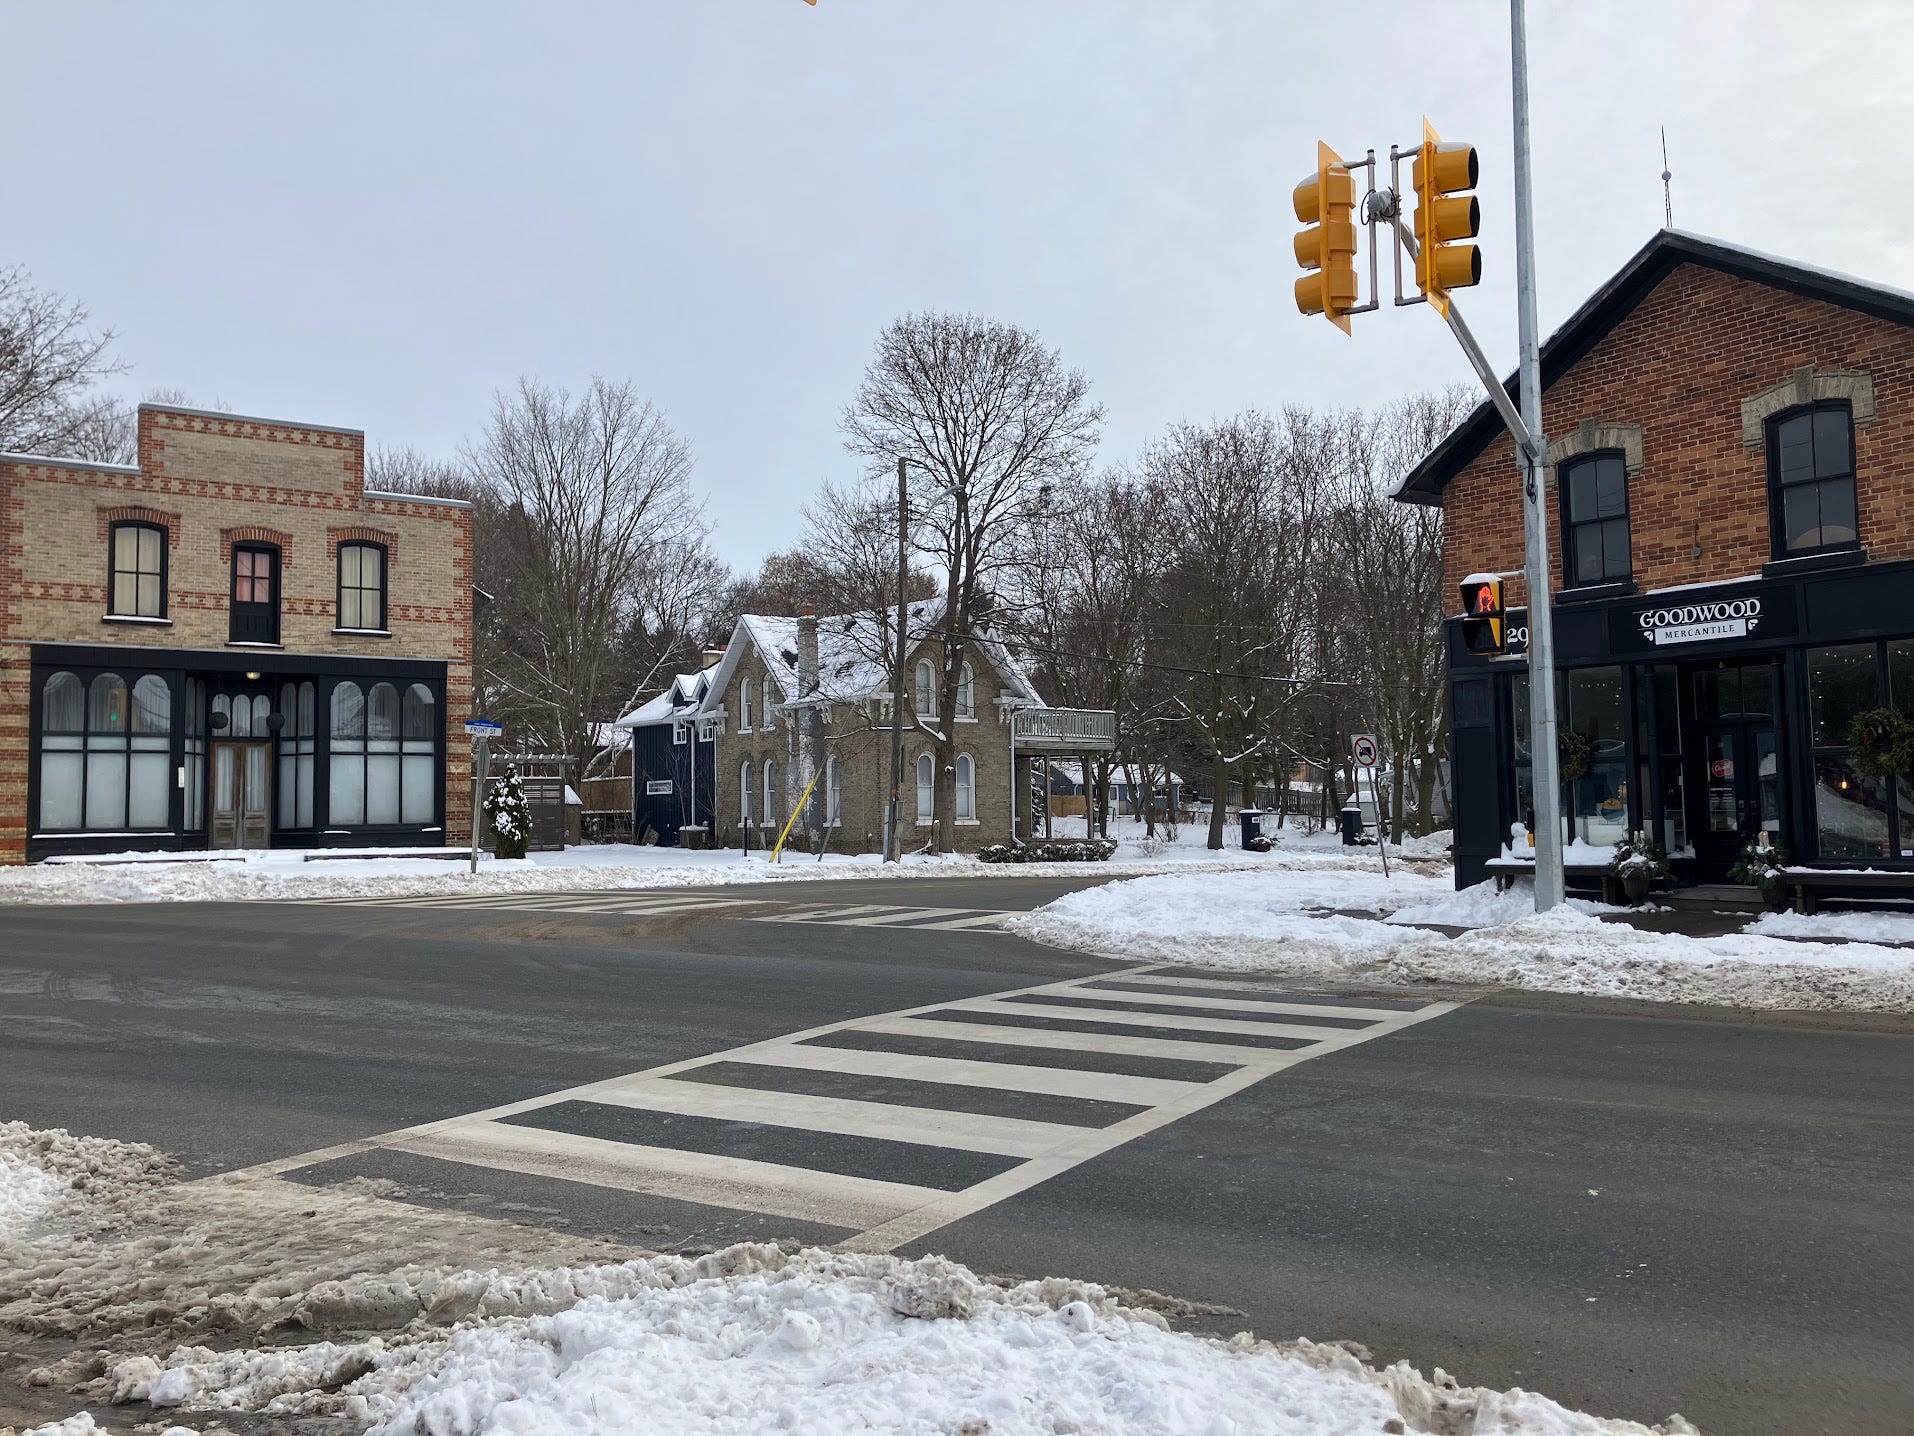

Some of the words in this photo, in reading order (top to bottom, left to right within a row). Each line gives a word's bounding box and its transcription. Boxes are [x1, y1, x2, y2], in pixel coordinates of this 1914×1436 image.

[1639, 599, 1760, 628] GOODWOOD
[1664, 624, 1735, 639] MERCANTILE
[470, 726, 488, 734] FRONT
